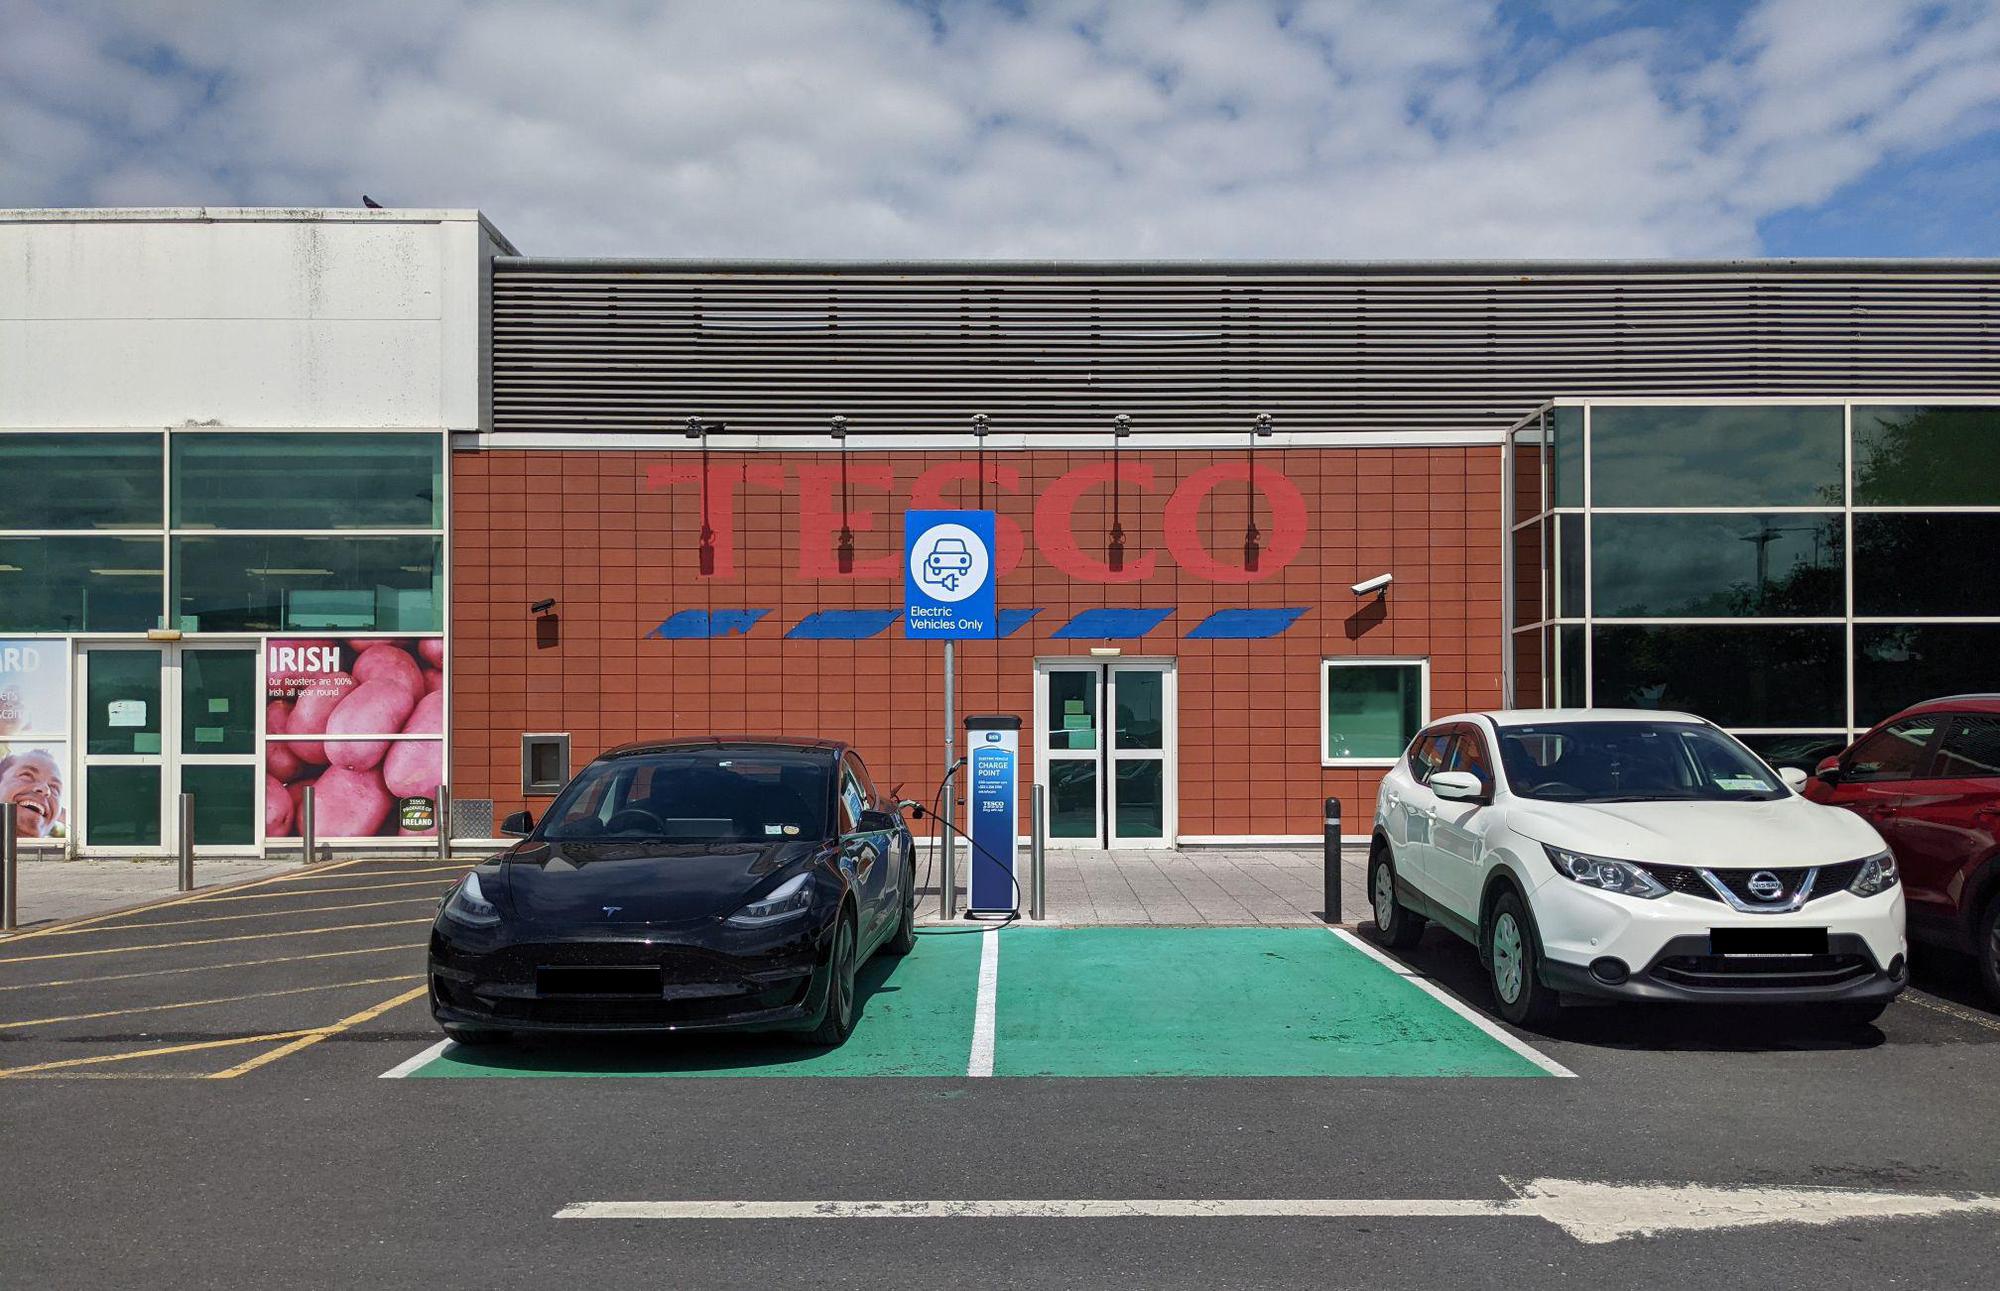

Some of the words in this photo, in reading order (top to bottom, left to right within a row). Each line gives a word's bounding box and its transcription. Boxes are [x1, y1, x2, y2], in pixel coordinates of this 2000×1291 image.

[647, 461, 1308, 585] TESCO
[910, 605, 953, 617] Electric
[910, 618, 956, 630] Vehicles
[958, 618, 983, 632] Only
[0, 646, 41, 673] RD
[269, 646, 340, 673] IRISH
[268, 678, 282, 686] Our
[284, 677, 317, 686] Roosters
[318, 678, 331, 686] are
[334, 677, 353, 686] 100%
[268, 687, 284, 697] Irish
[286, 687, 296, 697] all
[297, 688, 315, 699] year
[316, 687, 340, 697] round
[978, 761, 1009, 770] CHARGE
[978, 769, 1001, 777] POINT
[402, 818, 433, 826] IRELAND
